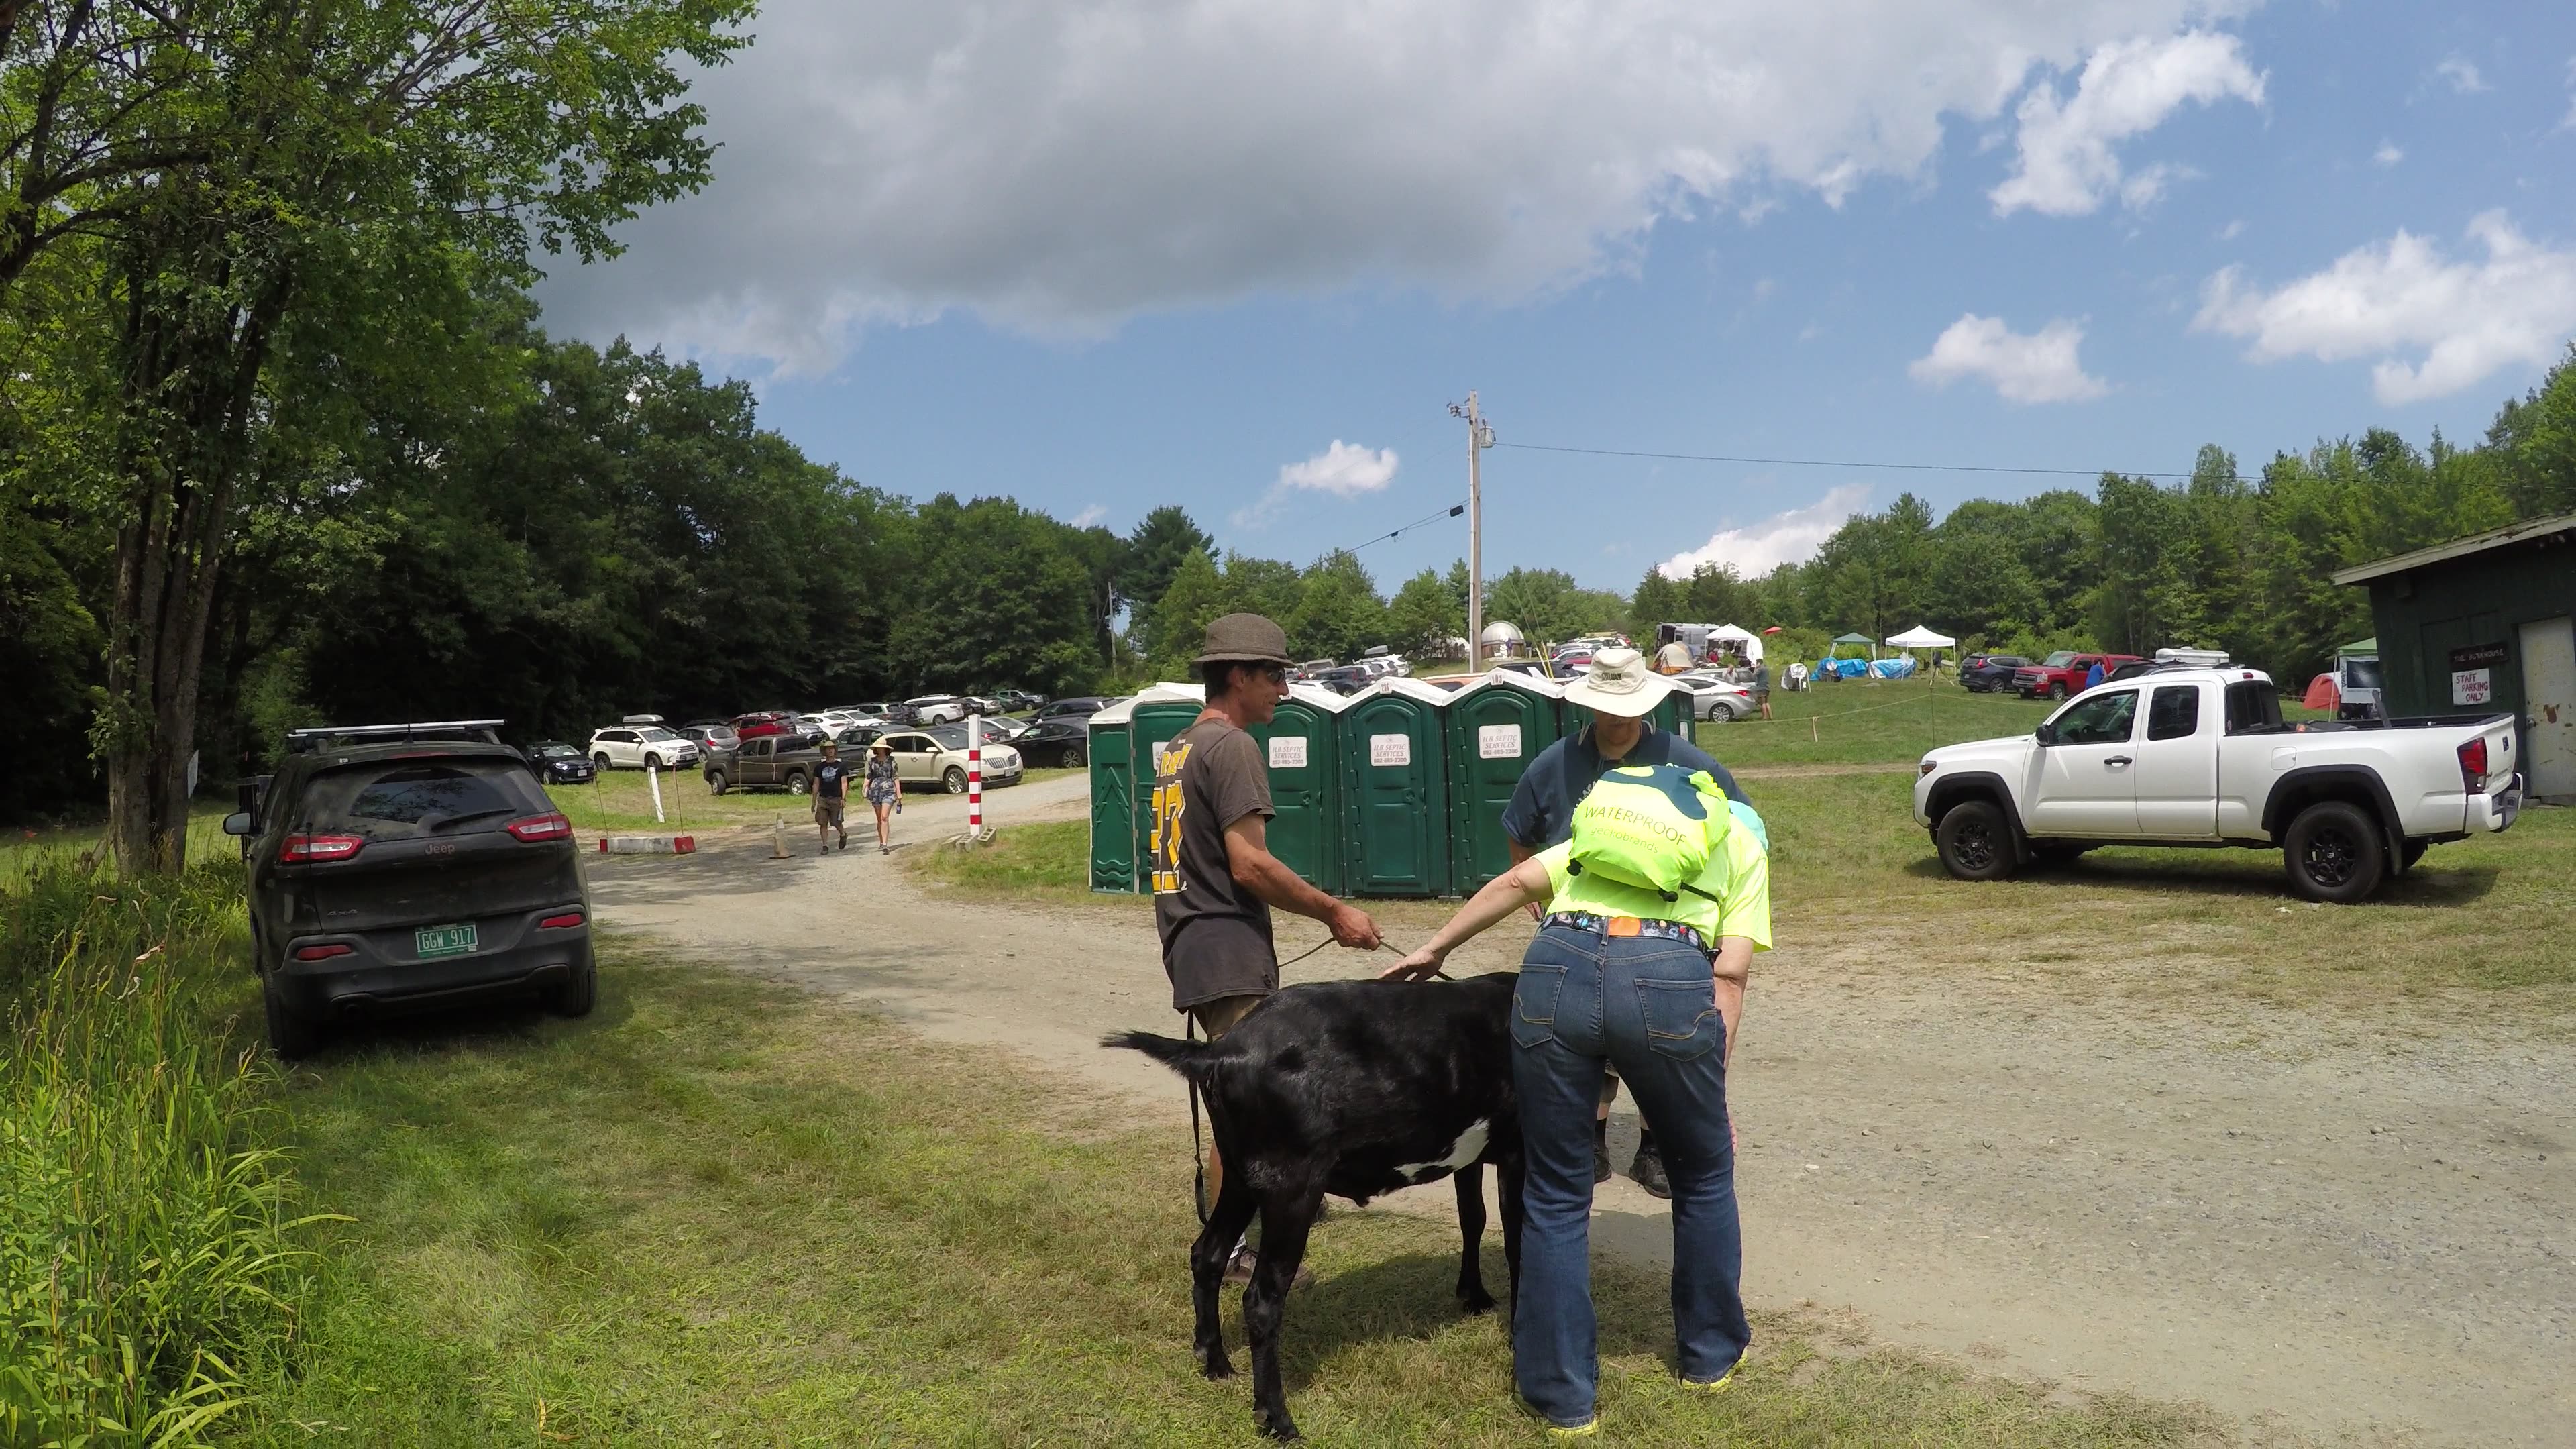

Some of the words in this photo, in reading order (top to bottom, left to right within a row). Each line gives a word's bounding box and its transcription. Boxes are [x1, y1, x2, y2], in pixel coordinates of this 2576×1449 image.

[2456, 673, 2477, 684] STAFF
[2461, 681, 2489, 692] PARKING
[2465, 692, 2484, 702] ONLY
[1495, 734, 1517, 742] SEPTIC
[1485, 741, 1515, 749] SERVICES
[1585, 806, 1687, 845] WATERPROOF
[1590, 826, 1660, 854] geckobrands
[425, 844, 455, 855] Jeep
[421, 931, 444, 949] GGW
[450, 928, 472, 945] 917
